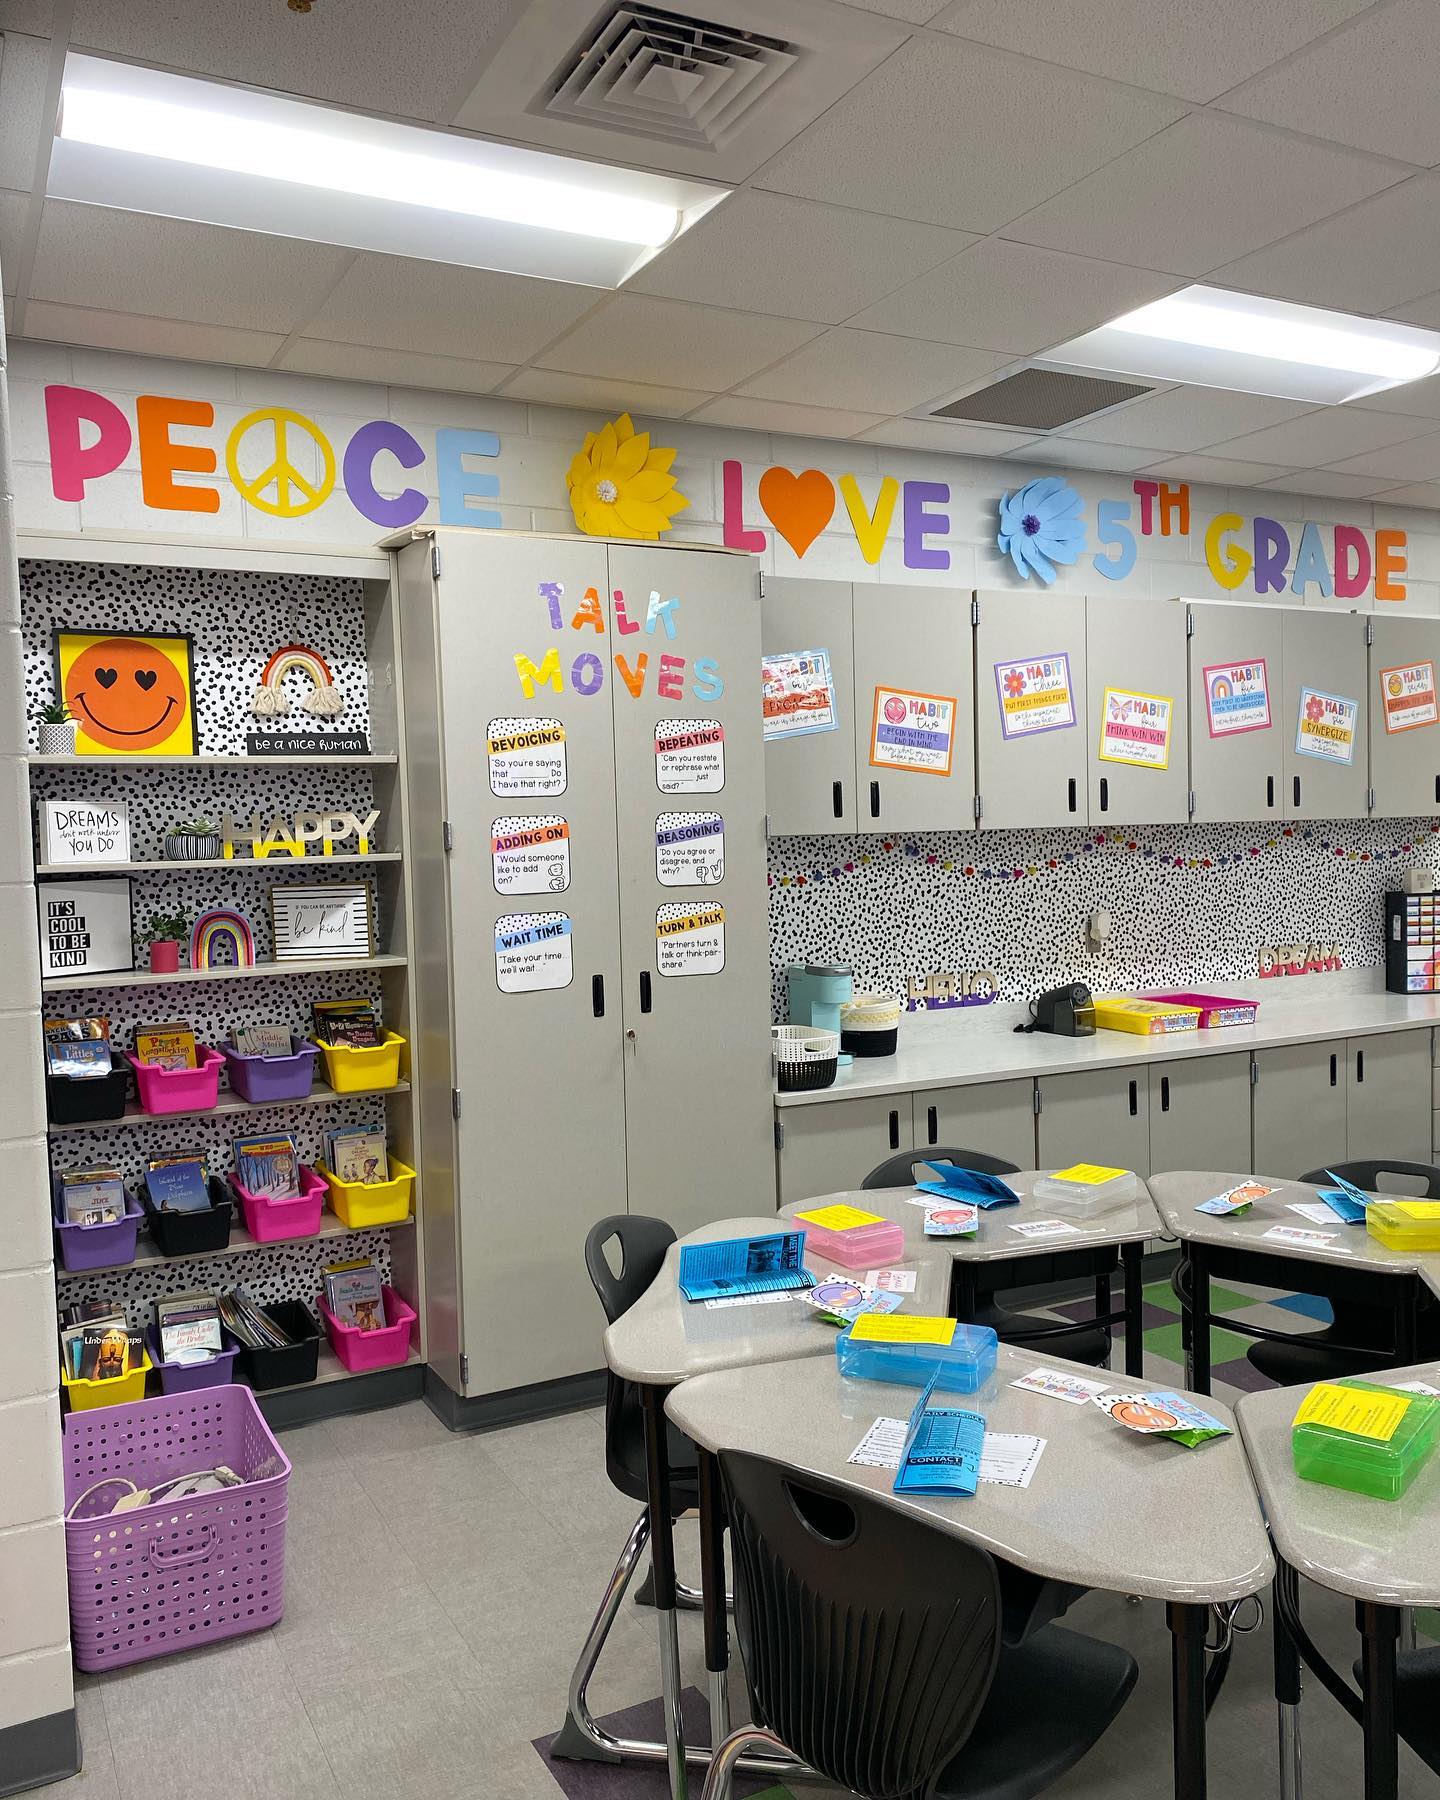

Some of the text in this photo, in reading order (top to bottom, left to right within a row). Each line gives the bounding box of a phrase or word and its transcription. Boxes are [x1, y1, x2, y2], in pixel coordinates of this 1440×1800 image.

[45, 384, 501, 529] PECE
[723, 460, 951, 570] LVE
[1204, 512, 1407, 600] GRADE
[537, 582, 680, 640] TALK
[513, 647, 724, 702] MOVES
[781, 659, 820, 676] ABIT
[1026, 661, 1061, 680] HABIT
[1231, 666, 1260, 683] HABIT
[1403, 668, 1429, 683] HABIT
[1033, 677, 1061, 692] three
[909, 700, 949, 719] HABIT
[1134, 700, 1167, 718] HABIT
[1325, 700, 1353, 718] HABIT
[916, 717, 939, 731] two
[1307, 723, 1348, 742] SYNERGIZE
[491, 730, 561, 752] REVOICING
[658, 731, 720, 752] REPEATING
[887, 727, 938, 742] BEGIN WITH THE
[1107, 724, 1165, 742] THINK WIN WIN
[255, 738, 362, 751] be a nice human
[894, 737, 907, 745] END
[917, 741, 933, 749] MIND
[508, 759, 534, 768] you're
[535, 759, 562, 768] saying
[679, 755, 692, 763] you
[492, 769, 562, 778] that Do
[671, 764, 702, 772] rephrase
[498, 780, 518, 789] have
[520, 780, 536, 788] that
[695, 774, 709, 782] just
[54, 810, 119, 831] DREAMS
[60, 828, 121, 839] don't work unless
[221, 810, 381, 859] HAPPY
[496, 828, 563, 851] ADDING ON
[657, 823, 720, 844] REASONING
[69, 837, 114, 856] YOU DO
[528, 854, 565, 862] someone
[497, 864, 539, 874] like to add
[50, 901, 74, 916] IT'S
[50, 918, 85, 934] COOL
[294, 911, 349, 939] be kind
[657, 913, 722, 935] TURN & TALK
[51, 934, 87, 950] TO BE
[501, 924, 564, 948] WAIT TIME
[713, 938, 718, 947] &
[50, 951, 85, 968] KIND
[523, 954, 542, 963] your
[661, 951, 674, 959] talk
[1258, 940, 1342, 979] DREAM
[908, 970, 998, 1012] HELLO
[65, 1048, 95, 1060] Littles
[789, 1235, 798, 1268] MEET THE
[84, 1336, 109, 1345] Under
[910, 1456, 961, 1464] CONTACT
